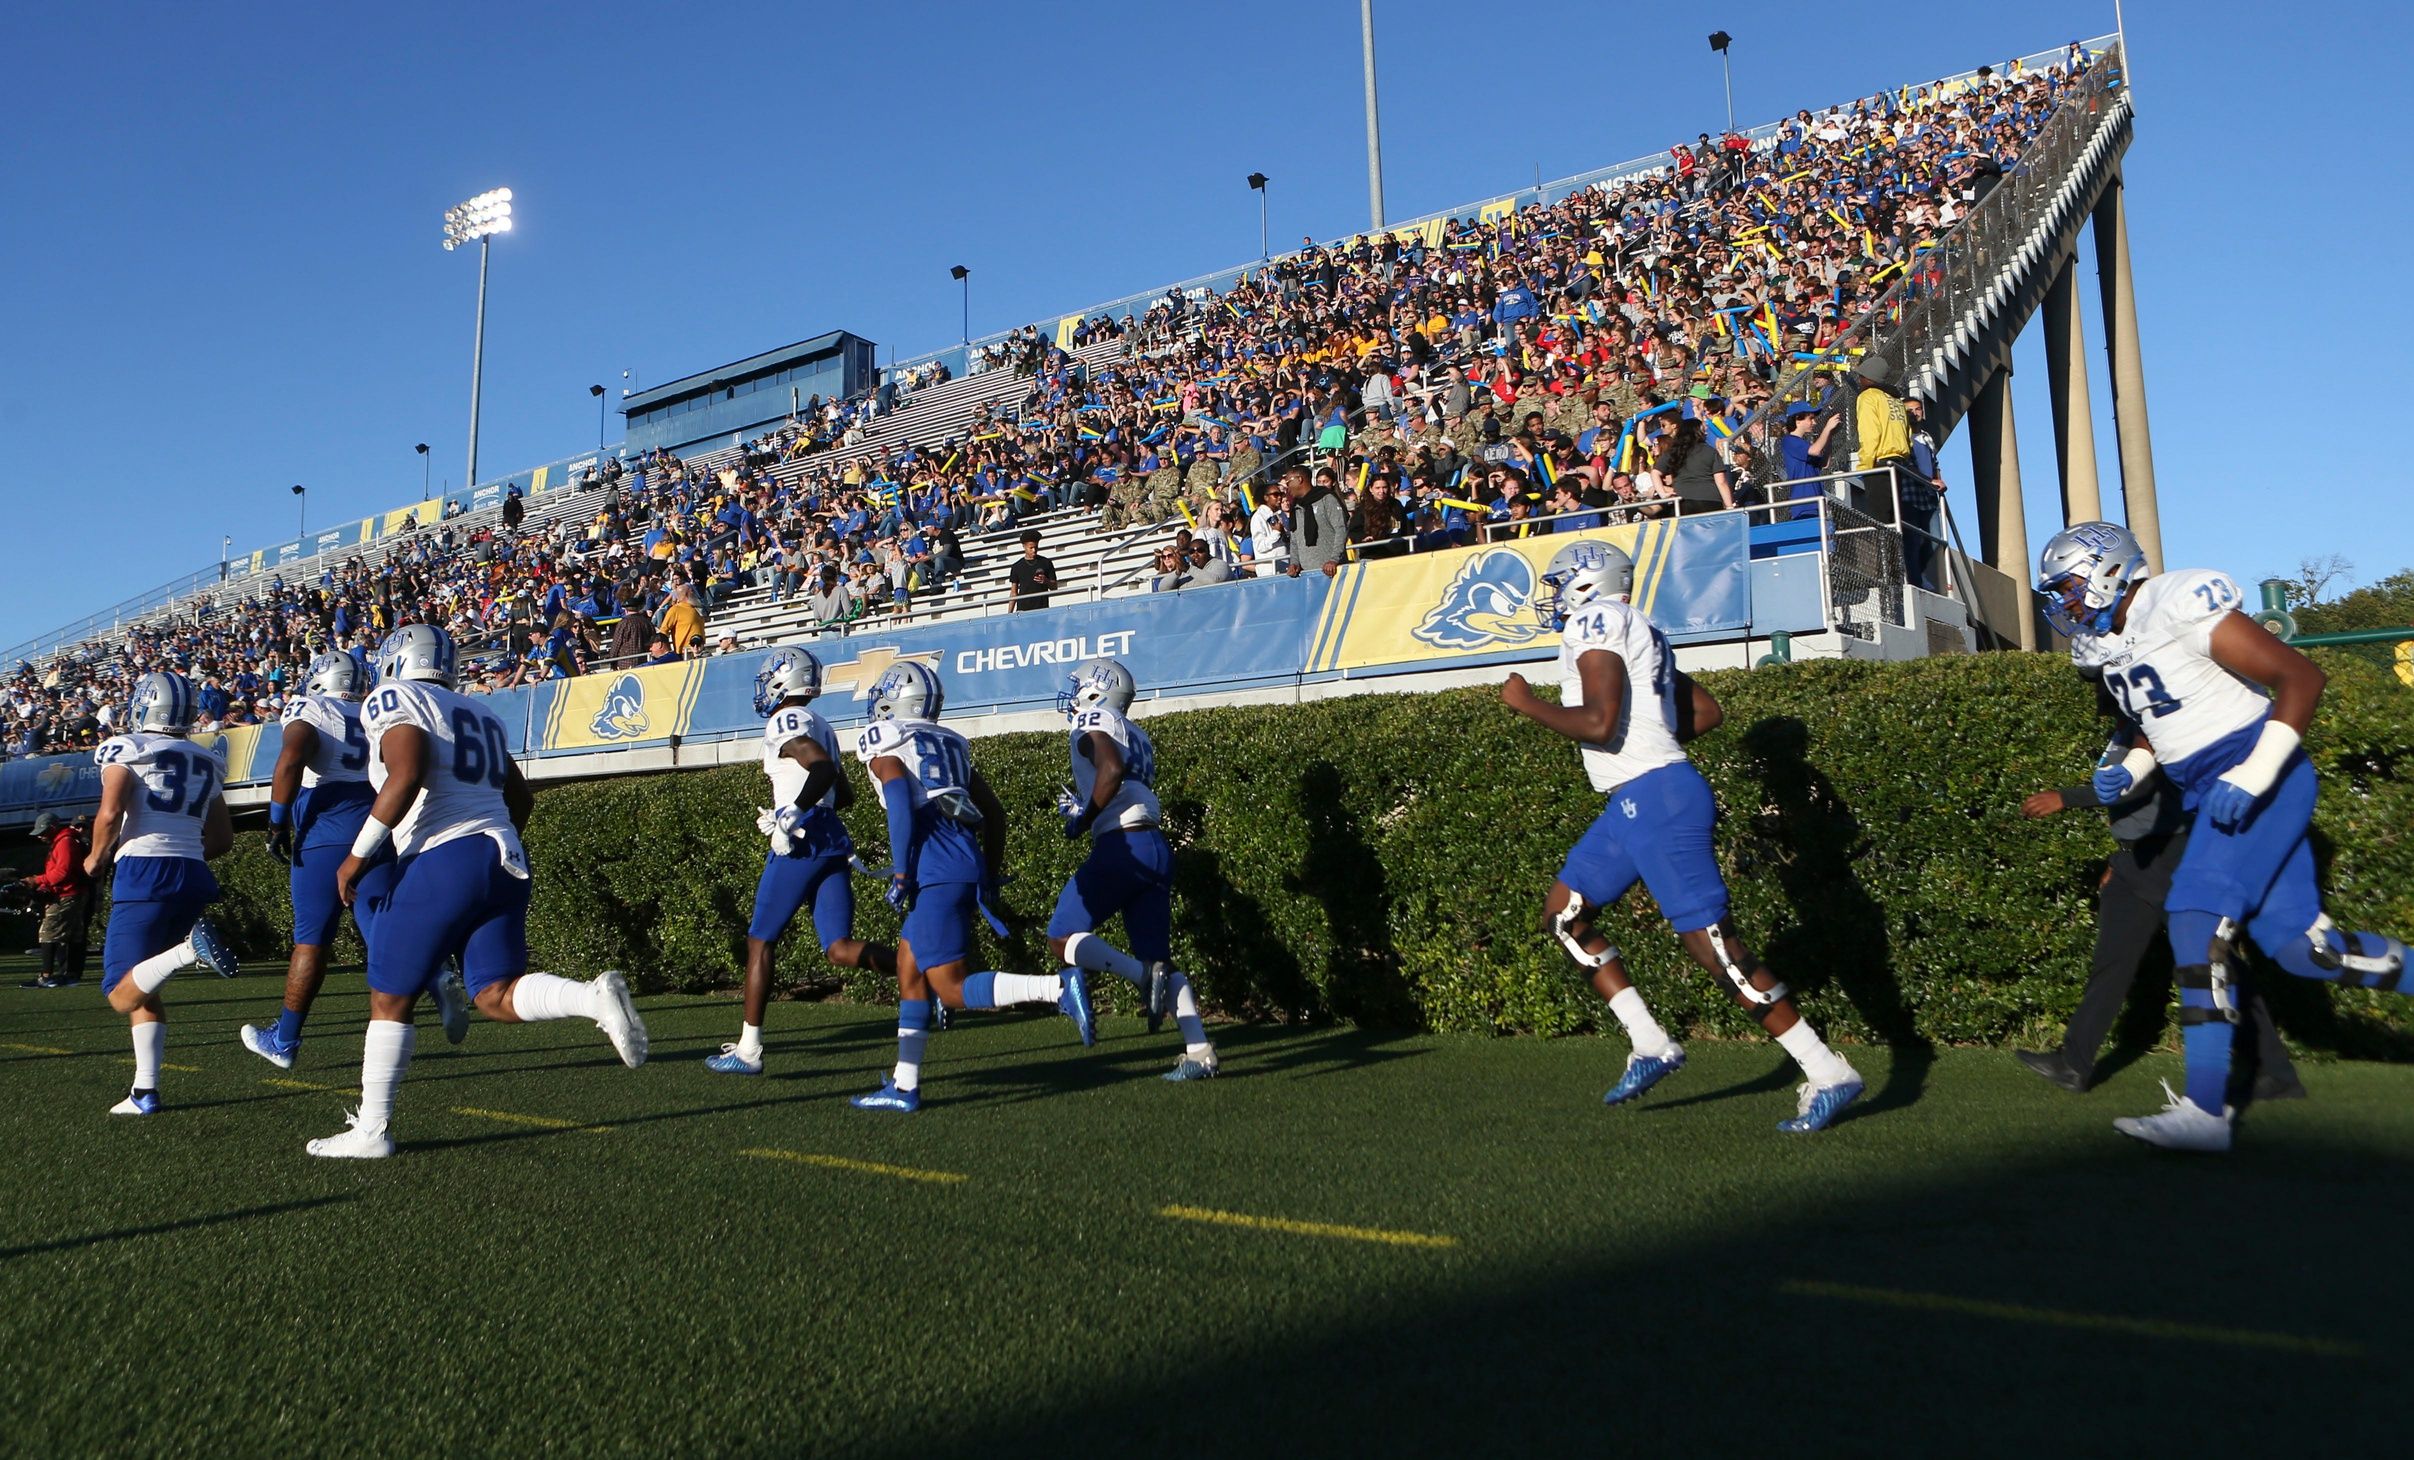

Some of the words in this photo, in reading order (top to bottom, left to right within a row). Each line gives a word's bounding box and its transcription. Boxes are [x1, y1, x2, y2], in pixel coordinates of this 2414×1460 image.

[1483, 445, 1509, 461] AERO
[473, 485, 499, 499] ANCHOR
[2192, 578, 2233, 612] 73
[1577, 612, 1606, 640] 74
[957, 630, 1136, 674] CHEVROLET
[367, 689, 401, 721] 60
[2104, 662, 2183, 725] 73
[284, 701, 306, 718] 57
[776, 713, 799, 733] 16
[1077, 712, 1102, 728] 82
[96, 744, 124, 764] 37
[341, 714, 371, 771] 5
[452, 707, 508, 790] 60
[858, 726, 882, 754] 80
[914, 730, 970, 790] 80
[145, 749, 214, 818] 37
